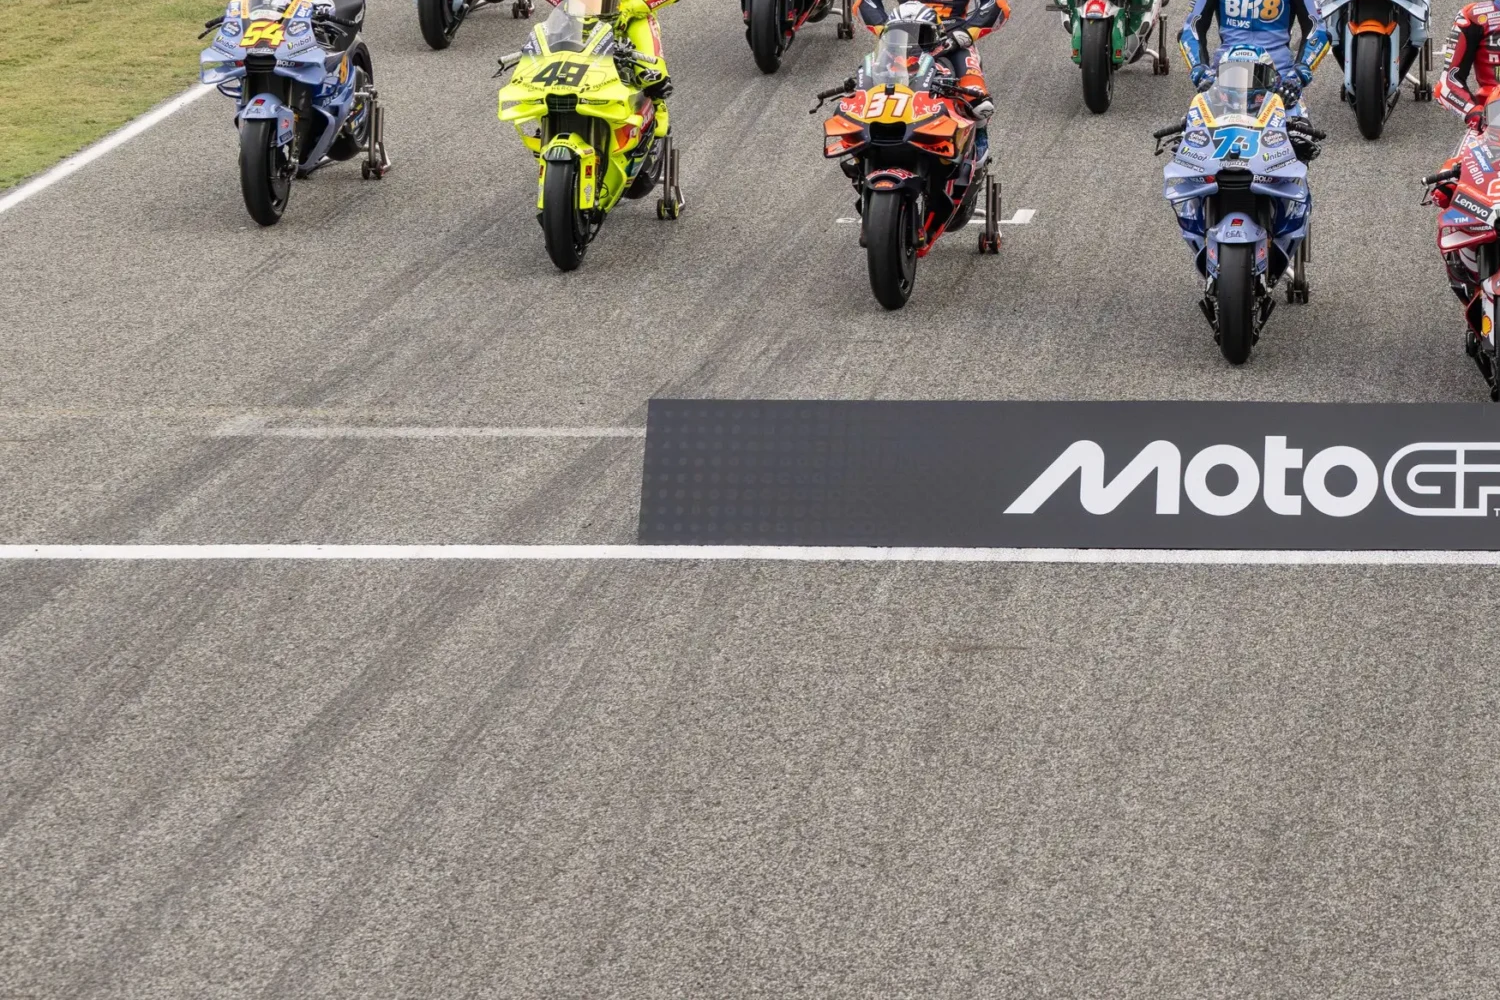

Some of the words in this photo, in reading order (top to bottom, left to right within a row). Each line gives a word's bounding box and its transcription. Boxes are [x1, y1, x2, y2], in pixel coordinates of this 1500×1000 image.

[240, 21, 286, 48] 54
[1226, 17, 1251, 29] NEWS
[531, 60, 590, 87] 49
[592, 77, 619, 90] PERTAMINA
[864, 92, 912, 119] 37
[1258, 97, 1278, 125] Antangin
[1448, 93, 1465, 108] Lenovo
[1210, 127, 1263, 160] 73
[1253, 174, 1273, 184] BOLD
[1466, 160, 1485, 185] riello
[1454, 194, 1489, 218] Lenovo
[1454, 216, 1469, 224] TIM
